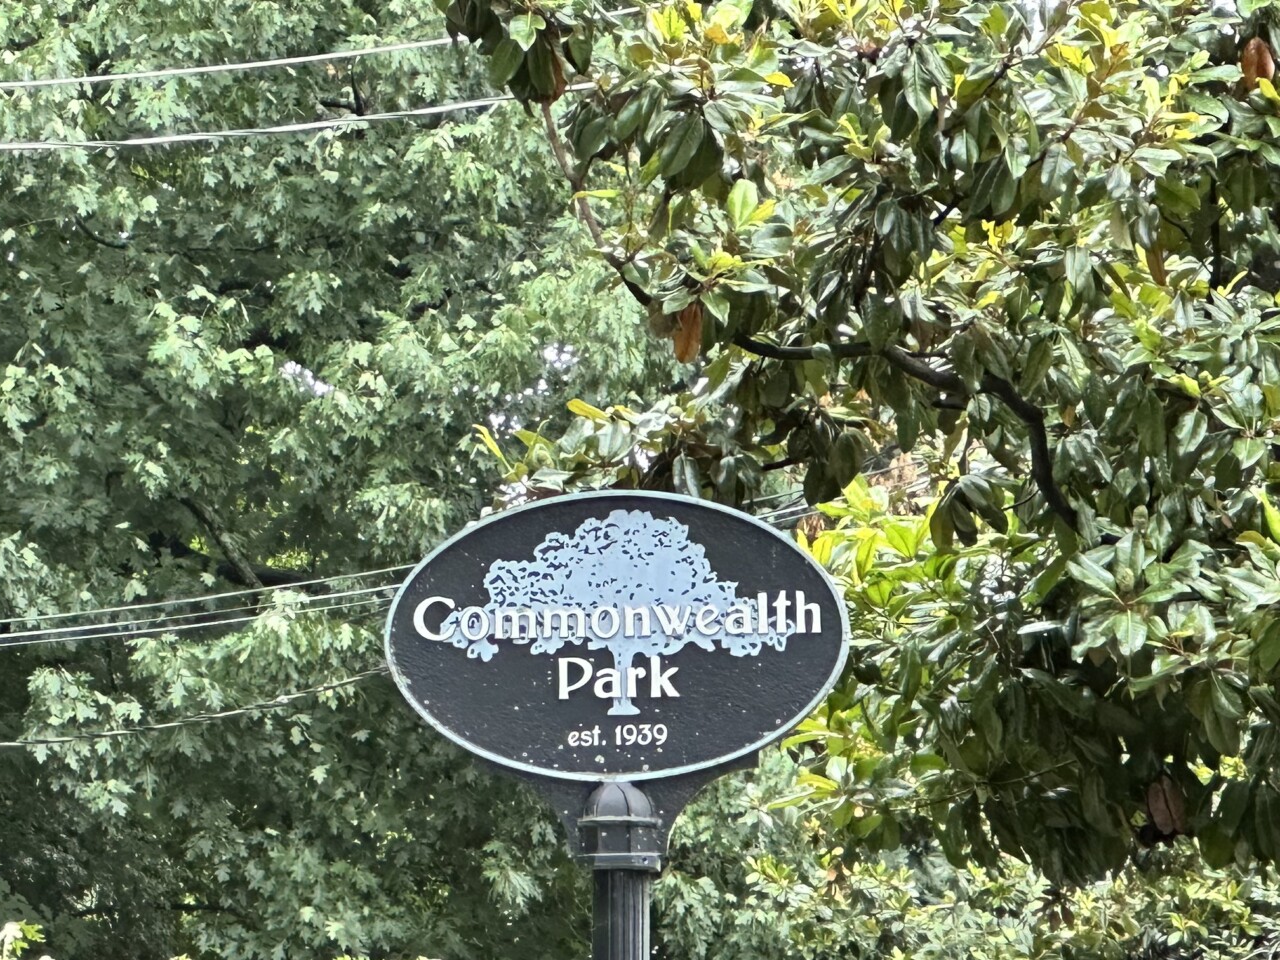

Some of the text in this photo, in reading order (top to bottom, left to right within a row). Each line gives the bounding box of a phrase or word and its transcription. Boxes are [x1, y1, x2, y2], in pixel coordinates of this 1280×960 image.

[413, 590, 822, 642] Commonwealth
[558, 656, 681, 700] Park
[567, 723, 668, 747] est. 1939
